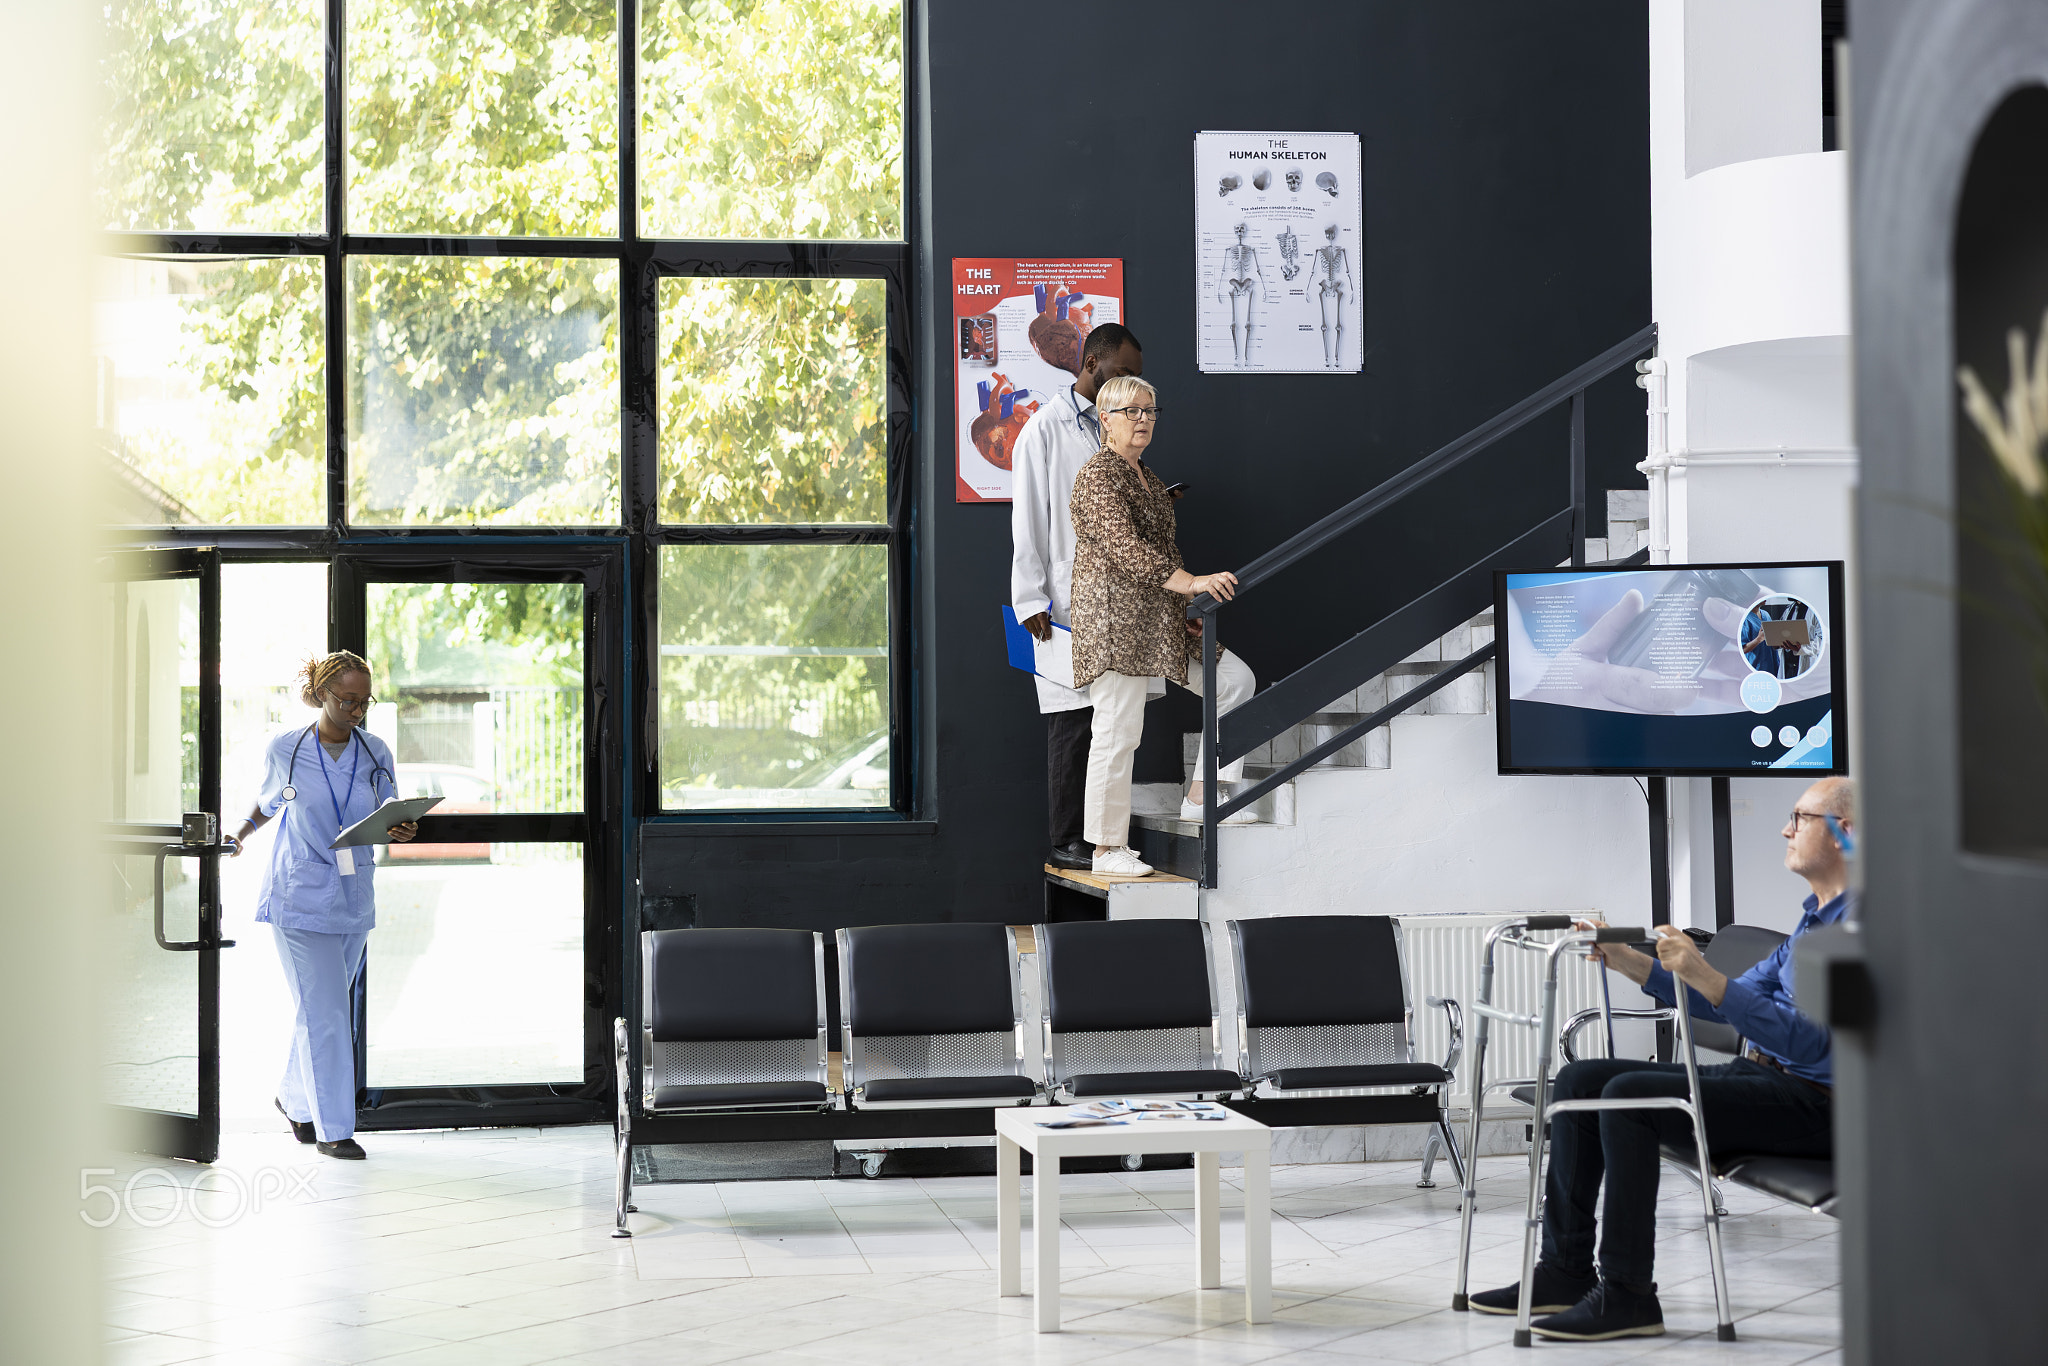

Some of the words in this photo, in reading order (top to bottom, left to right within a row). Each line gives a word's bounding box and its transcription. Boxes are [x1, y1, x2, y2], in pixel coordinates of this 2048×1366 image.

[1268, 140, 1288, 148] THE
[1229, 151, 1268, 160] HUMAN
[1271, 151, 1327, 160] SKELETON
[966, 269, 992, 279] THE
[957, 285, 1001, 295] HEART
[1747, 681, 1772, 690] FREE
[1750, 694, 1774, 703] CALL
